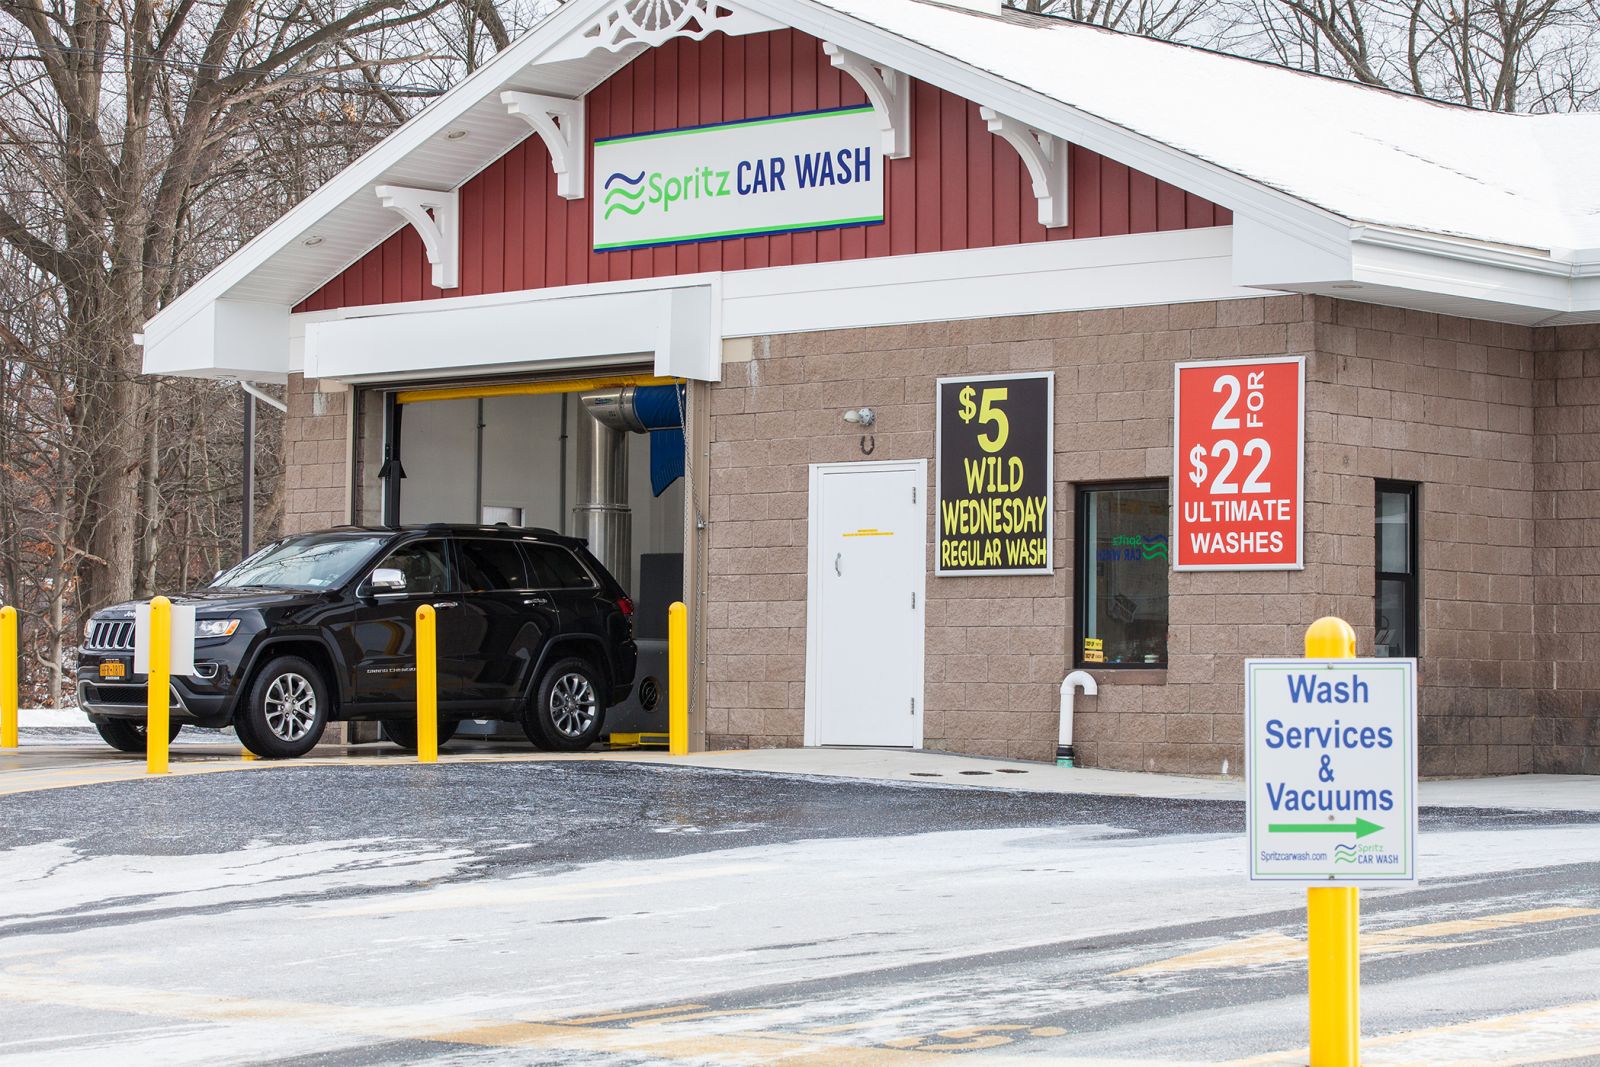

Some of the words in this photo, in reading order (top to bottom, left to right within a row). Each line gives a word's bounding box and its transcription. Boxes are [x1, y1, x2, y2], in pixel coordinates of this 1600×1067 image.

[648, 165, 731, 212] Spritz
[737, 156, 786, 196] CAR
[794, 145, 871, 189] WASH
[1211, 374, 1241, 430] 2
[1246, 370, 1265, 428] FOR
[958, 385, 1009, 453] $5
[964, 456, 1024, 494] WILD
[1188, 438, 1271, 495] $22
[942, 495, 1047, 535] WEDNESDAY
[1184, 499, 1291, 523] ULTIMATE
[942, 538, 1002, 567] REGULAR
[1005, 538, 1047, 566] WASH
[1190, 531, 1284, 554] WASHES
[1287, 674, 1369, 704] Wash
[1265, 719, 1393, 749] Services
[1318, 754, 1335, 783] &
[1266, 782, 1394, 811] Vacuums
[1260, 850, 1328, 862] Spritzcarwash.com
[1357, 843, 1384, 854] Spritz
[1357, 854, 1374, 864] CAR
[1375, 854, 1399, 864] WASH
